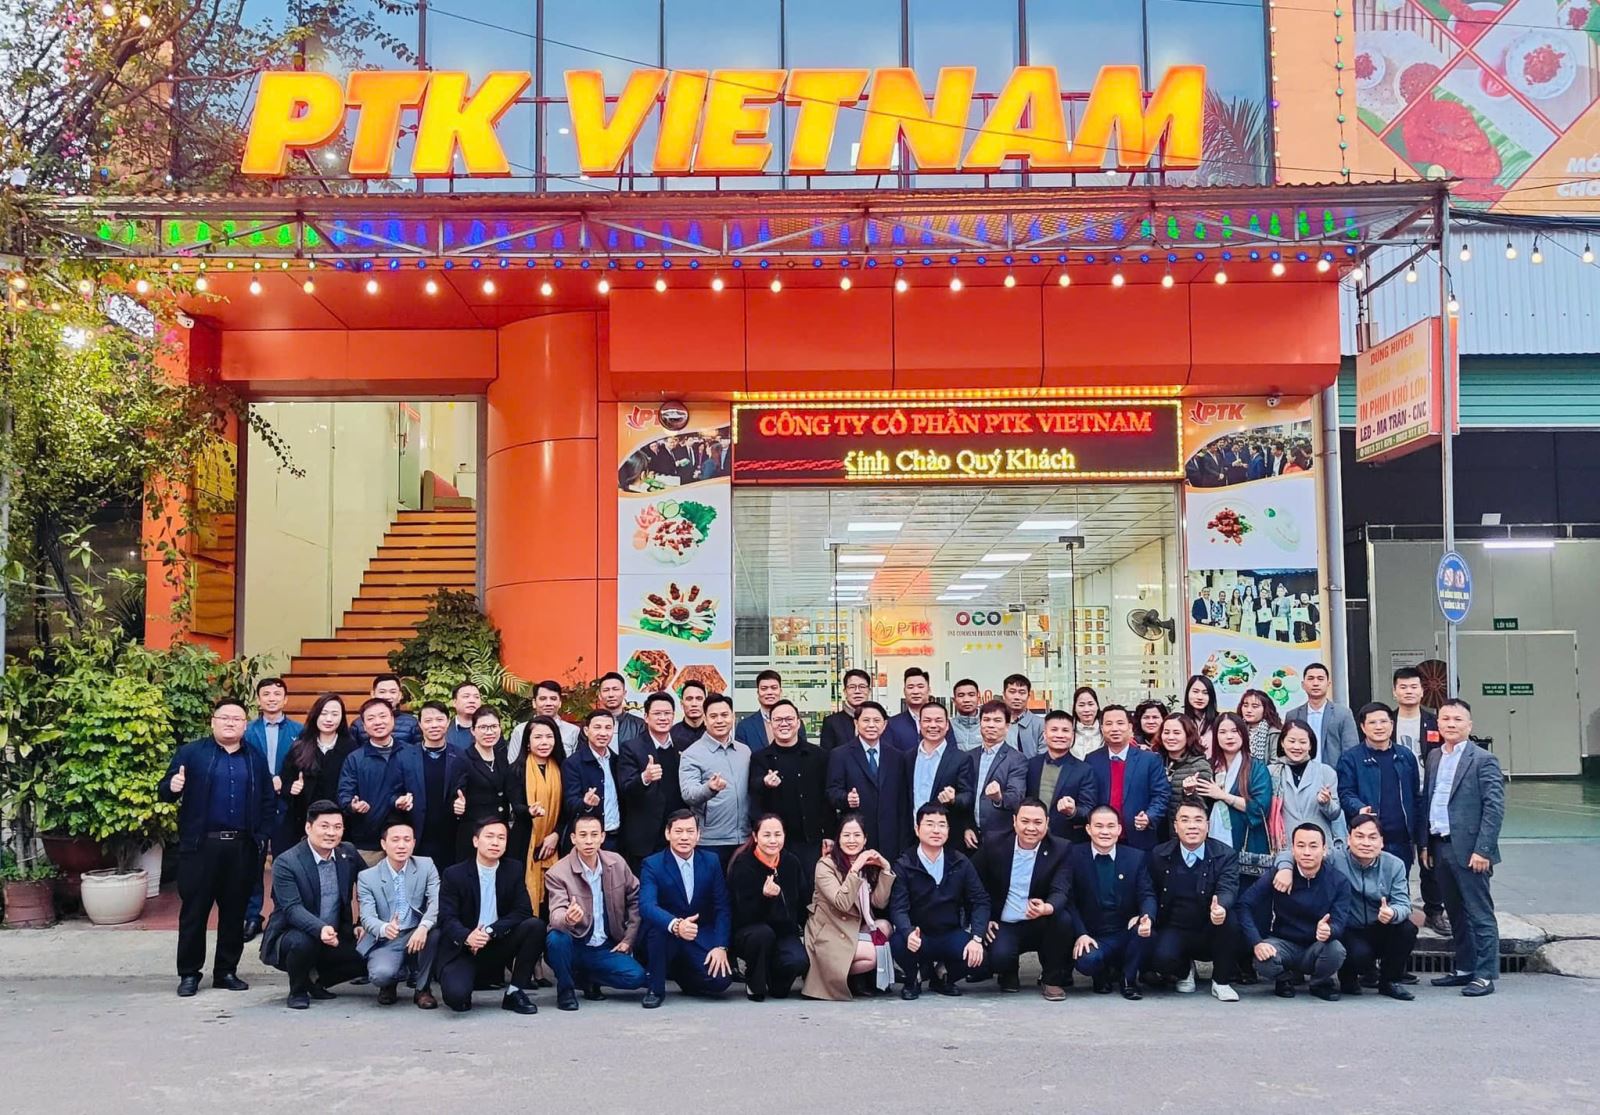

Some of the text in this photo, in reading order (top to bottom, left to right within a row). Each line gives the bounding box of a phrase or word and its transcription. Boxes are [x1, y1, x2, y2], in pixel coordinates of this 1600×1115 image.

[241, 65, 1206, 177] PTK VIETNAM
[759, 411, 832, 436] CÔNG
[834, 415, 869, 435] TY
[984, 413, 1033, 433] PTK
[1036, 412, 1152, 433] VIETNAM
[1203, 402, 1246, 421] PTK
[1360, 402, 1368, 421] IN
[1360, 424, 1372, 442] LED
[1377, 418, 1388, 436] MA
[1412, 401, 1427, 420] CNC
[895, 449, 950, 471] Chào
[956, 448, 1002, 474] Quý
[1006, 448, 1075, 470] Khách
[897, 621, 932, 636] PTK
